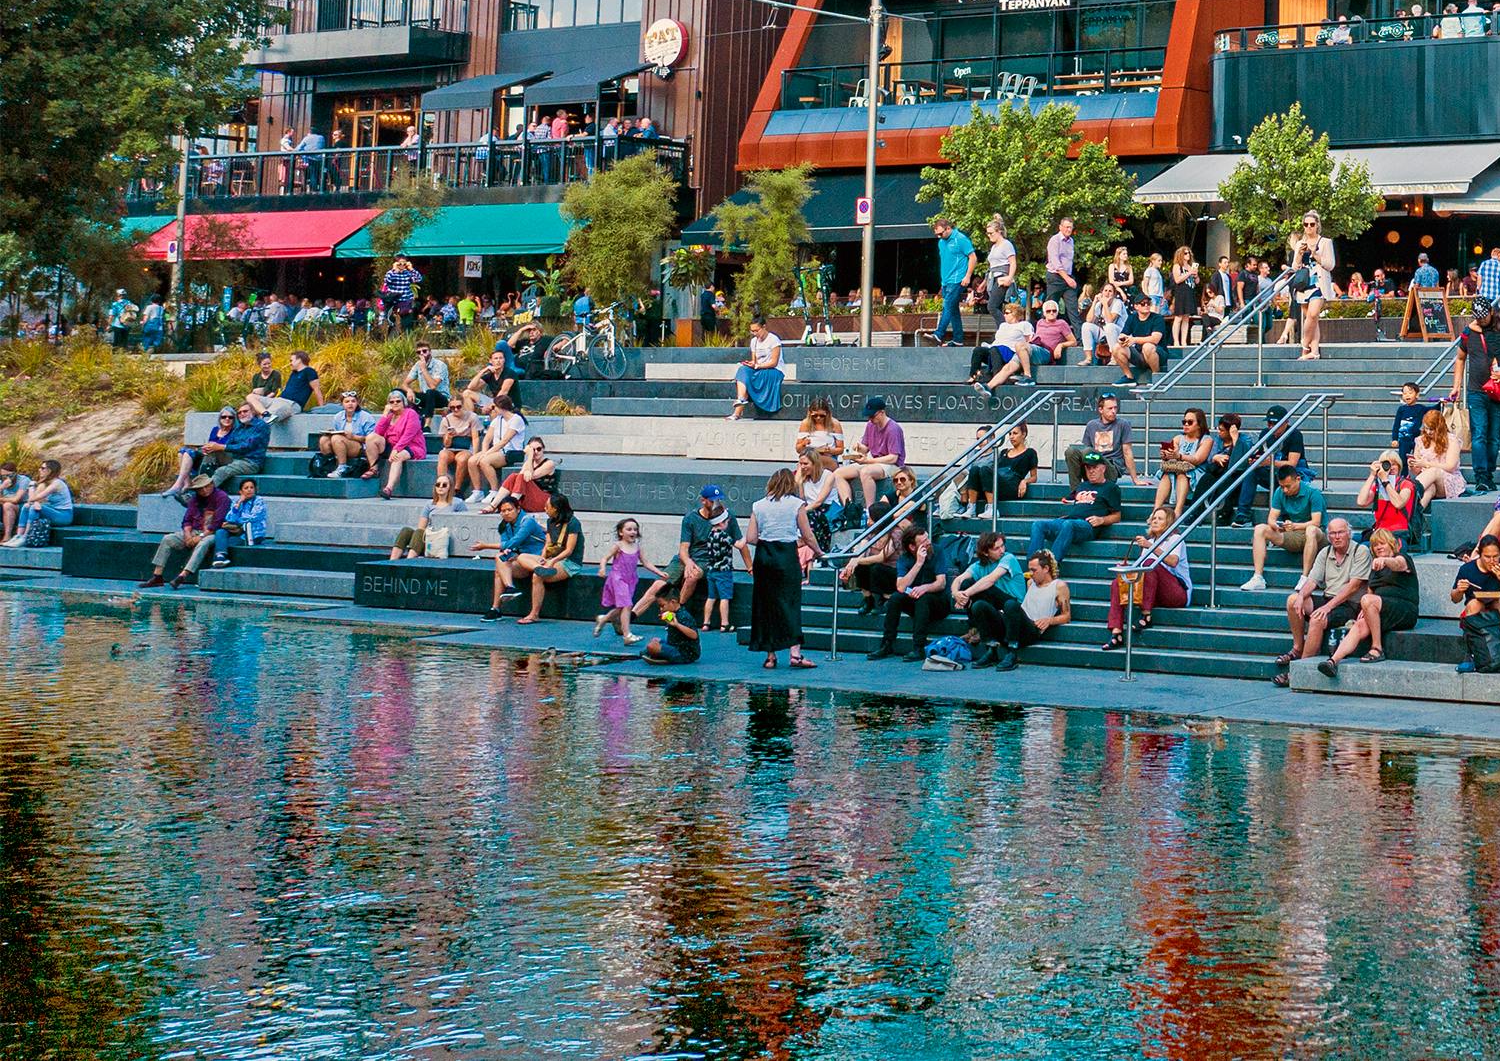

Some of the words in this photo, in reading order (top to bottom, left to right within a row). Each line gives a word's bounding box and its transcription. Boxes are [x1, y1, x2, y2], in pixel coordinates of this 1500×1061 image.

[953, 66, 972, 79] Open
[803, 356, 859, 372] BEFORE
[865, 357, 886, 371] ME
[839, 394, 862, 409] OF
[927, 395, 985, 411] FLOATS
[990, 396, 1100, 412] DOWNSTREA
[752, 432, 781, 447] THE
[561, 481, 630, 499] ERENELY
[637, 483, 680, 500] THEY
[362, 575, 421, 595] BEHIND
[425, 579, 449, 597] ME
